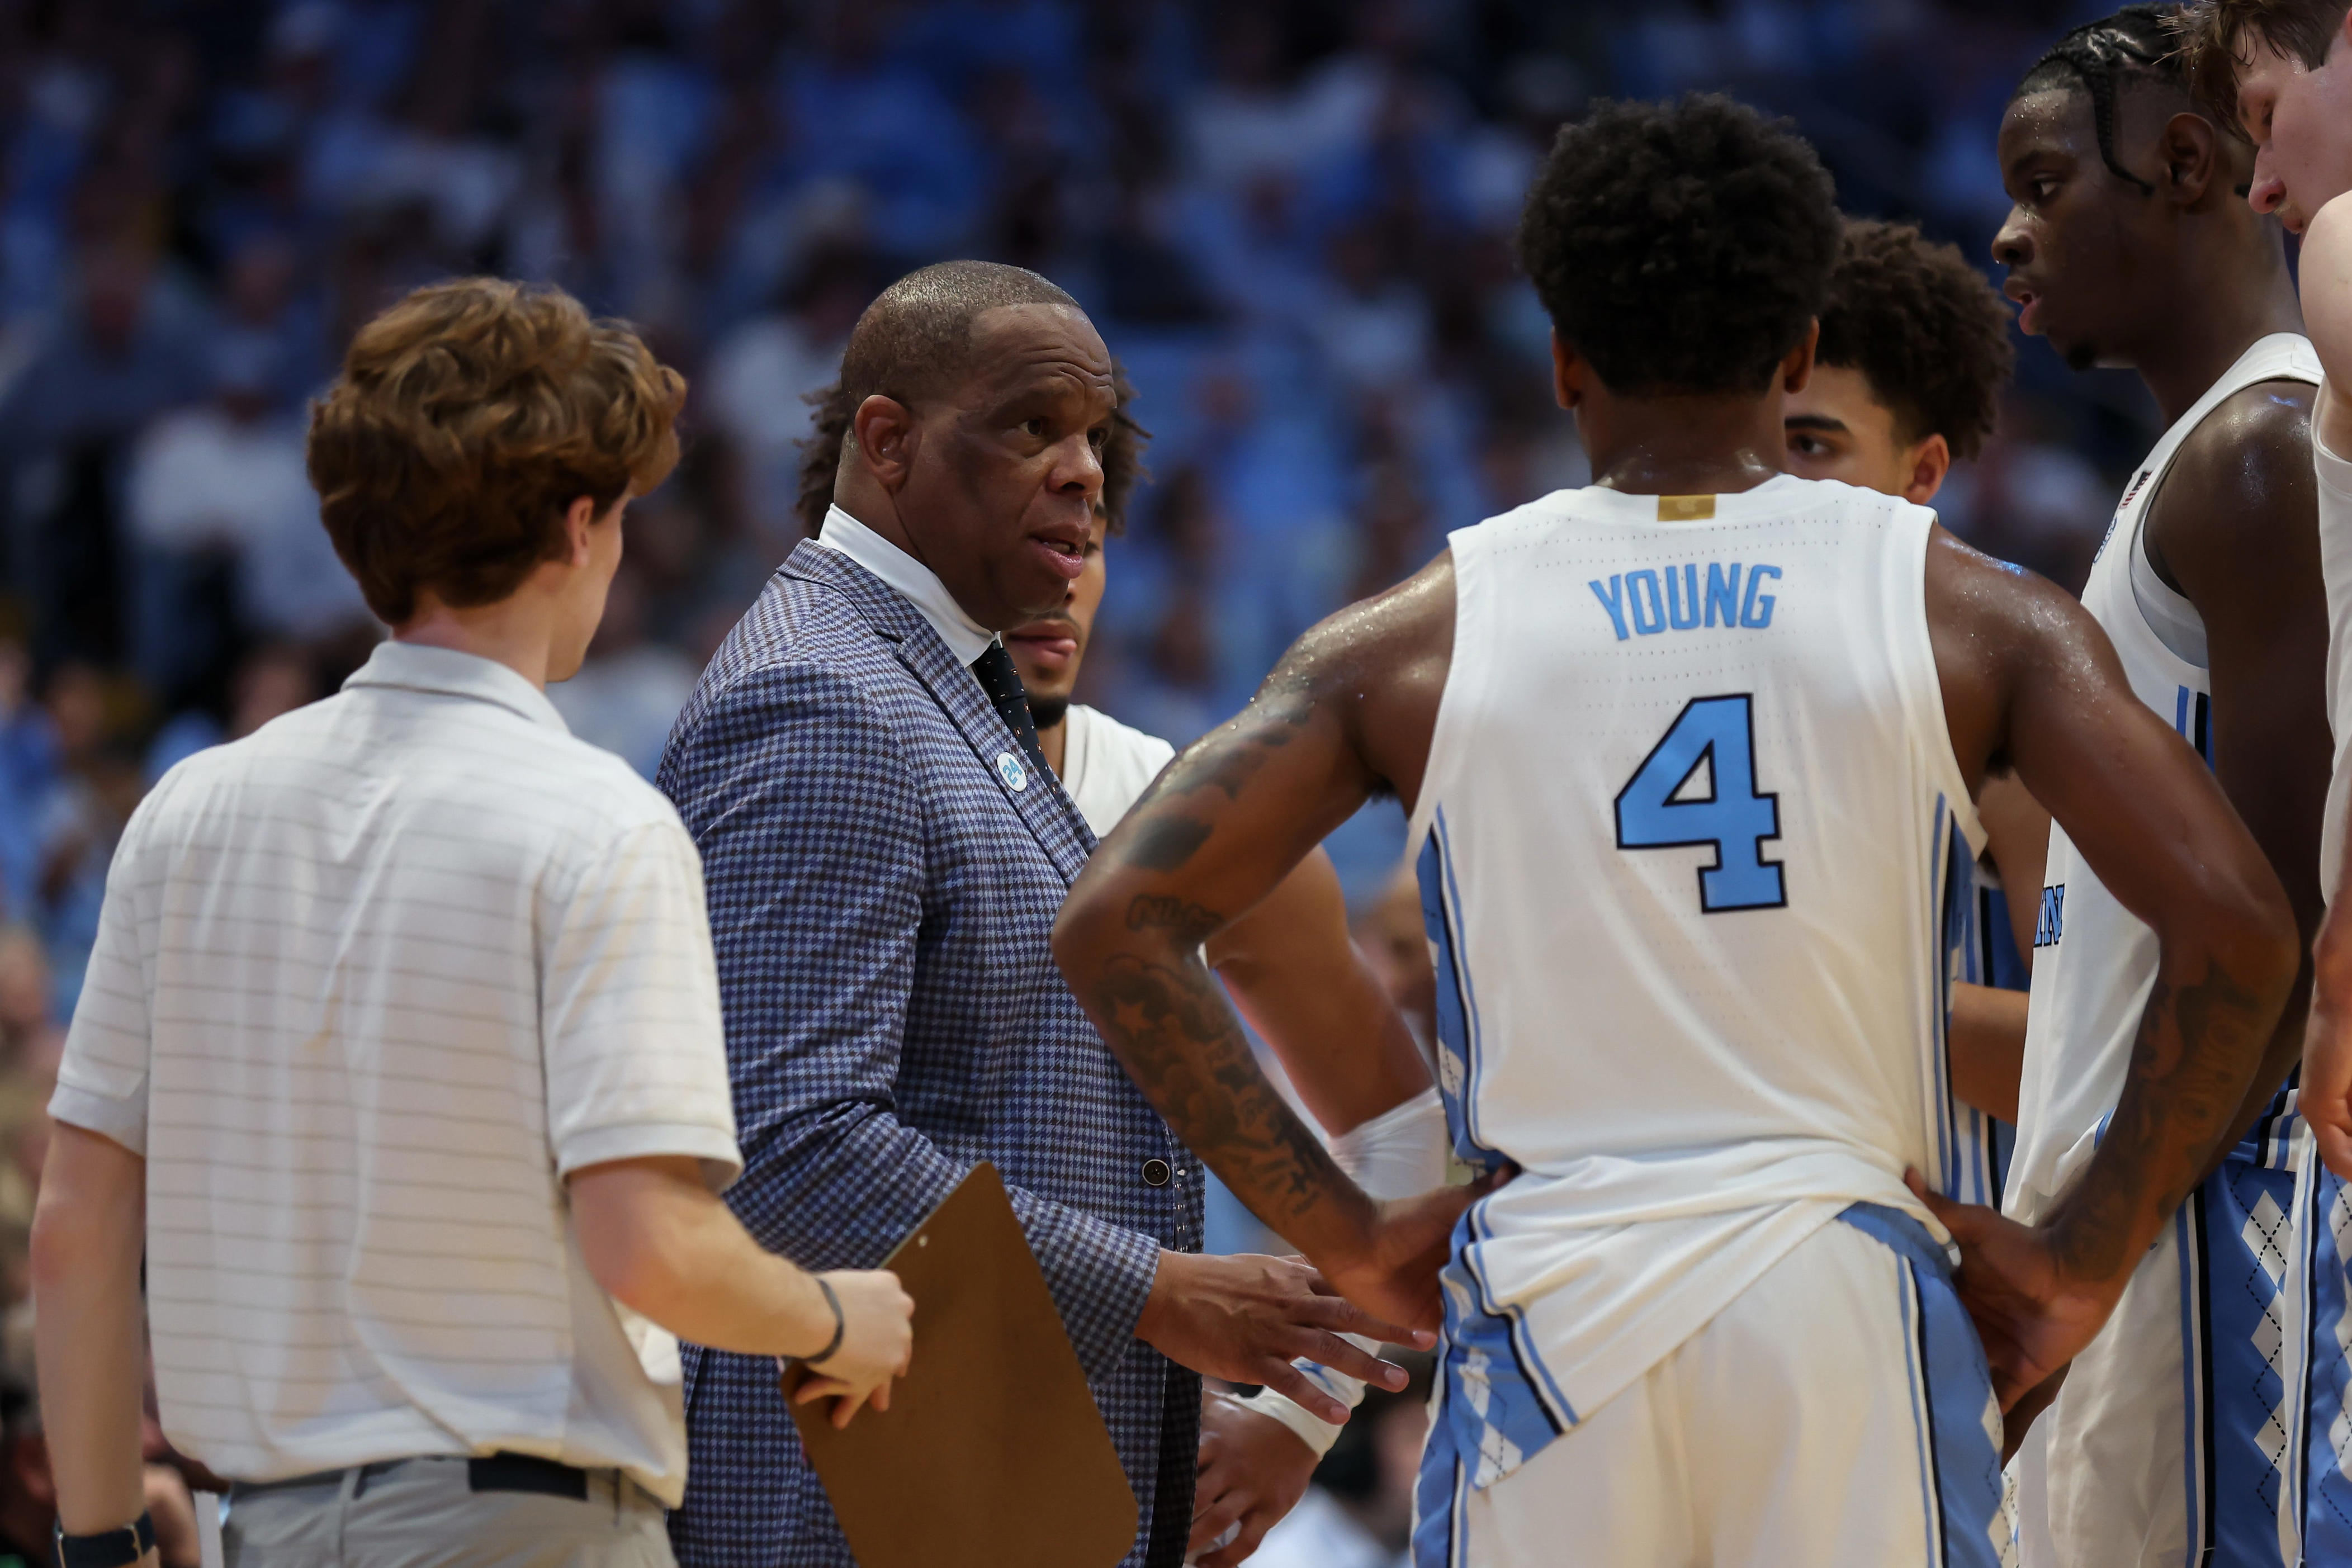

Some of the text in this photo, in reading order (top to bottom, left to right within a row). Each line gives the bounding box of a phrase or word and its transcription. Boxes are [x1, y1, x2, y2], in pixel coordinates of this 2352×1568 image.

[1588, 562, 1783, 641] YOUNG
[1002, 758, 1023, 785] 24
[1614, 693, 1788, 914] 4
